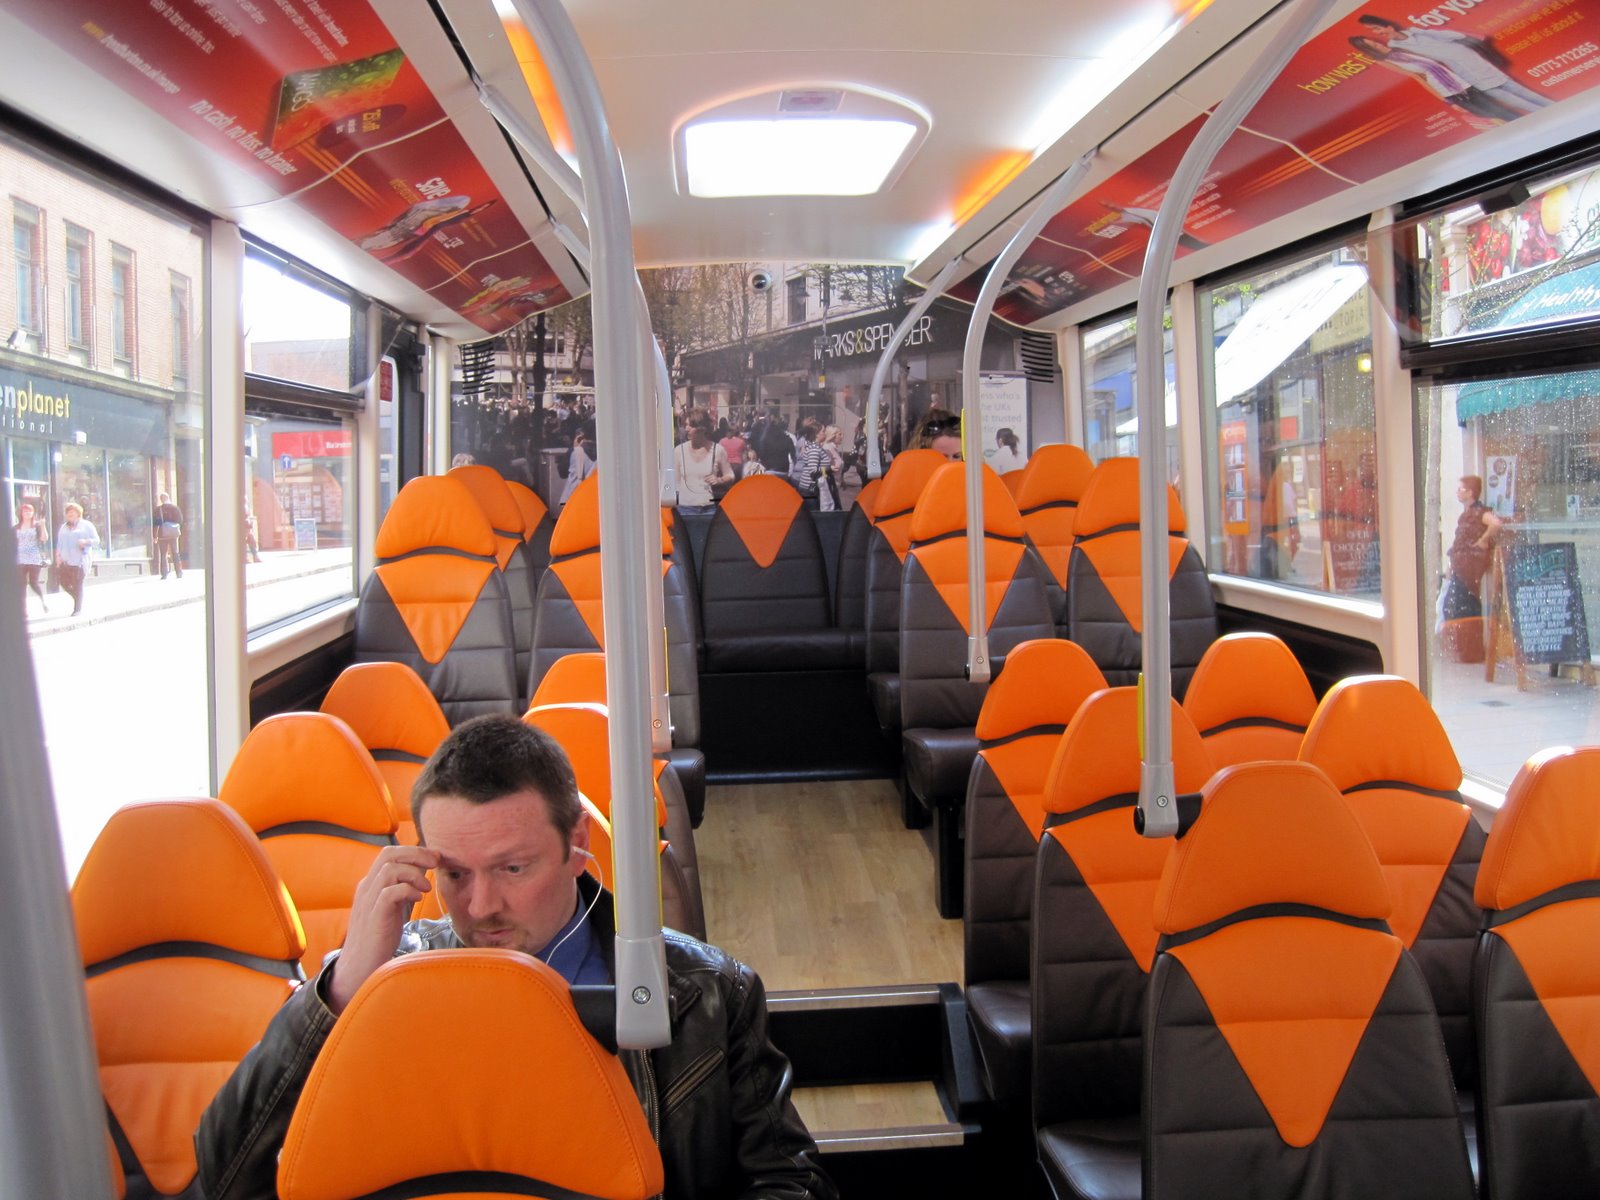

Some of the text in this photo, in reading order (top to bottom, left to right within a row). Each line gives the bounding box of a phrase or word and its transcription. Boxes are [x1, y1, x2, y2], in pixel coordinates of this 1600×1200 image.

[1408, 9, 1451, 28] for
[1438, 0, 1486, 16] yo
[1297, 52, 1377, 95] how was it
[1527, 42, 1599, 78] 01773 712265
[189, 99, 209, 116] no
[225, 124, 247, 139] no
[255, 146, 272, 160] no
[416, 177, 451, 200] save
[814, 316, 933, 361] MRKS&SPENER
[24, 484, 41, 498] SALE
[1333, 541, 1380, 553] CHOCOLAT
